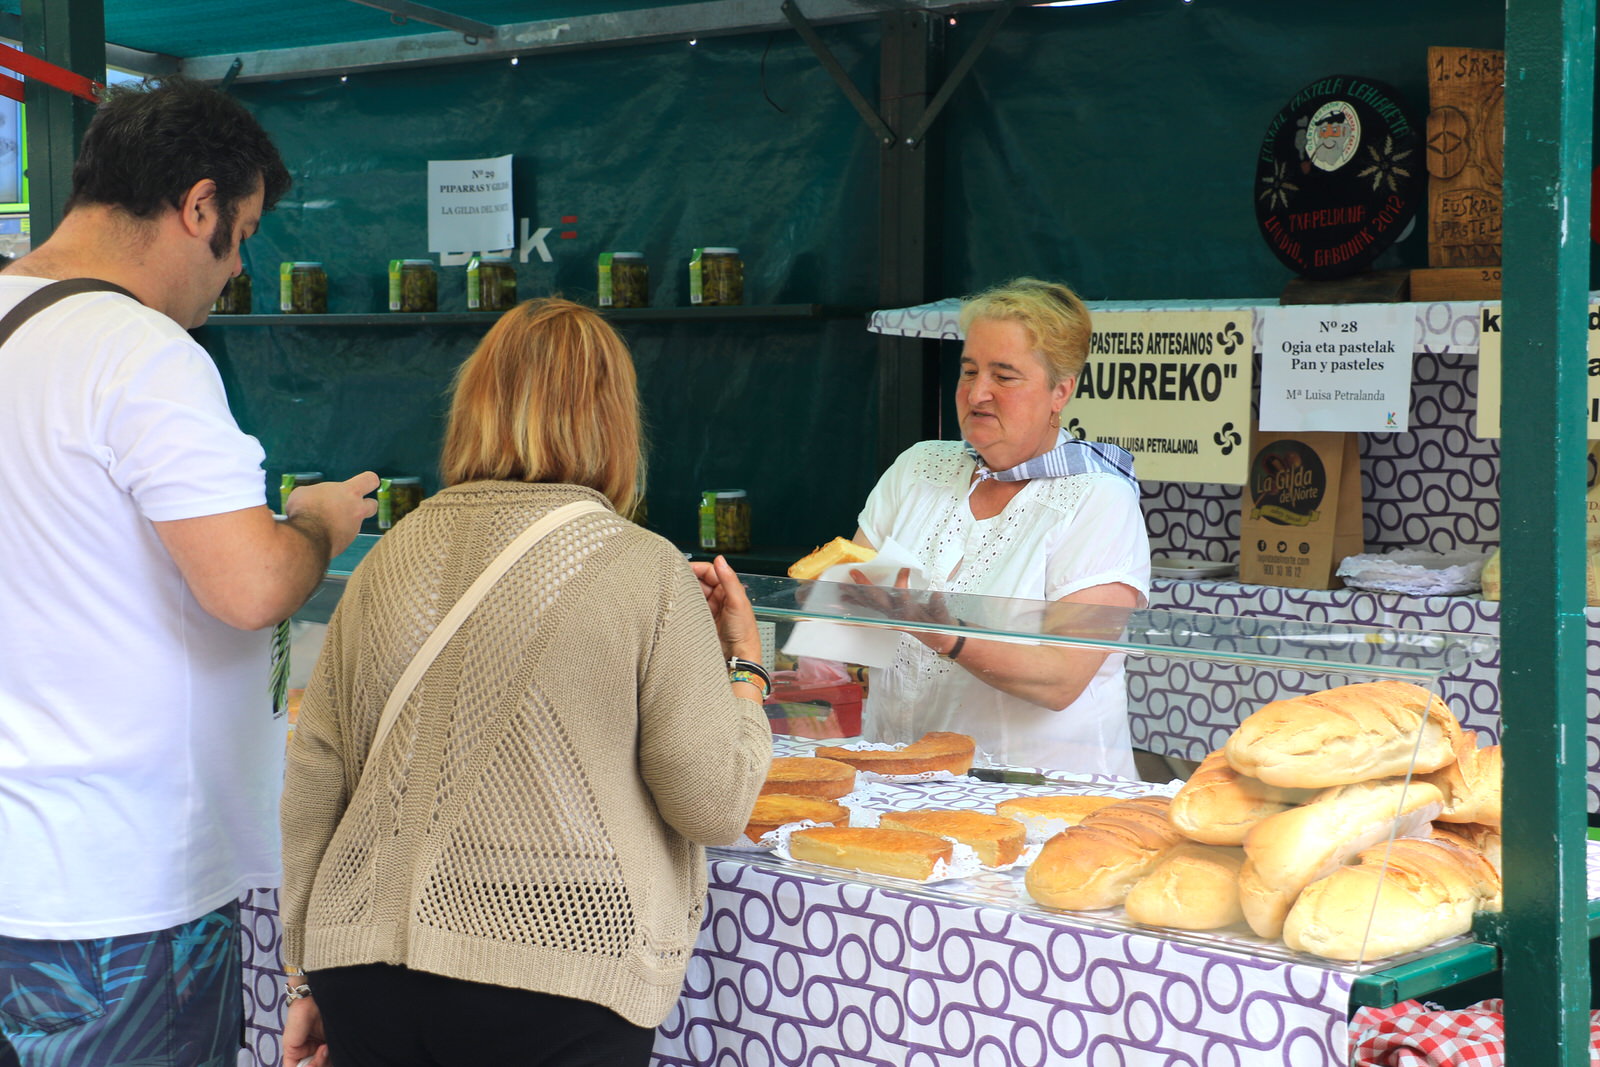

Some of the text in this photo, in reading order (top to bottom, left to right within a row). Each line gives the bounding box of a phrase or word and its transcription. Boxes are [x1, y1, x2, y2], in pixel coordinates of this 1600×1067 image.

[485, 170, 495, 180] 29
[440, 184, 485, 193] PIPARRAS
[485, 183, 491, 191] Y
[441, 206, 453, 215] LA
[454, 205, 480, 215] GILDA
[1442, 195, 1498, 216] EUSKAL
[1372, 194, 1406, 233] 2012
[1440, 218, 1502, 238] PASTEL
[1482, 271, 1501, 281] 20
[1319, 320, 1358, 333] Nº 28
[1091, 332, 1213, 355] PASTELES ARTESANOS
[1281, 340, 1395, 356] Ogia eta pastelak
[1291, 358, 1385, 373] Pan y pasteles
[1286, 389, 1385, 401] Mª Luisa Petralanda
[1122, 437, 1145, 452] LUISA
[1147, 438, 1199, 454] PETRALANDA
[1257, 464, 1313, 494] La Gilda
[1295, 486, 1319, 501] Norte
